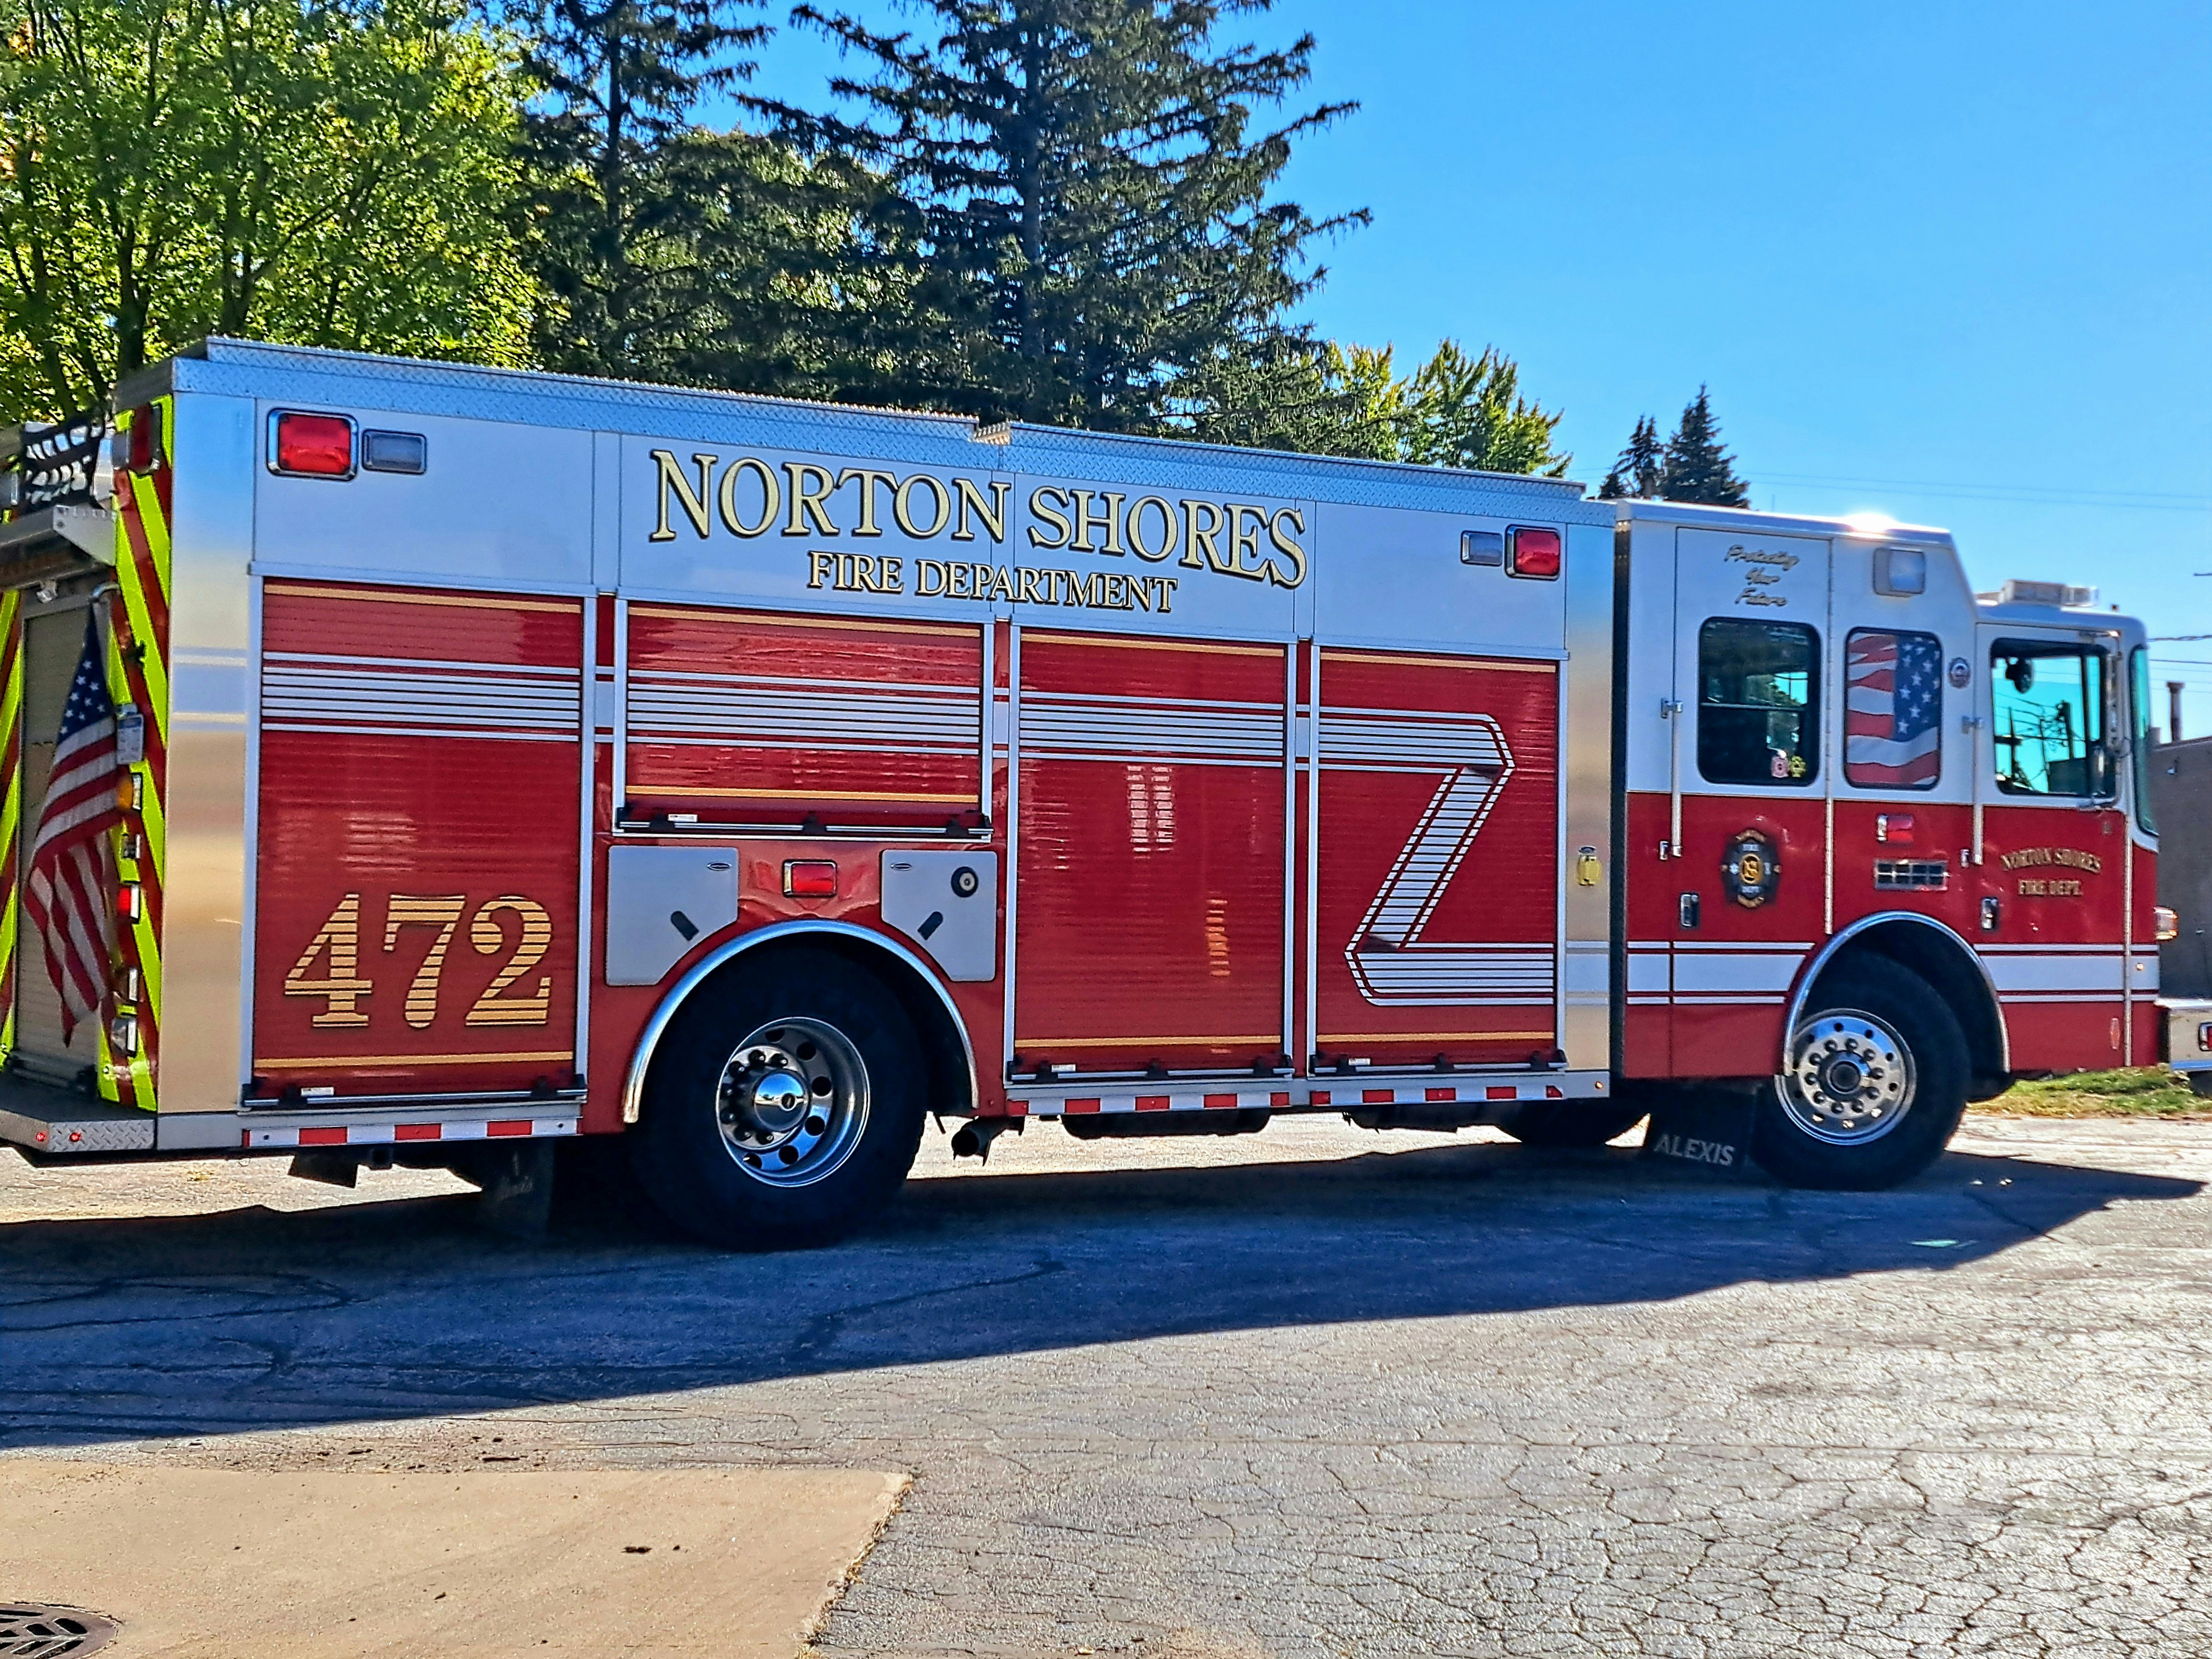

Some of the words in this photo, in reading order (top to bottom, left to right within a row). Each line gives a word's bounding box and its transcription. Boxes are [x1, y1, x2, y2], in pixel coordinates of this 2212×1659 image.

[649, 449, 1014, 543] NORTON
[1028, 485, 1307, 589] SHORES
[807, 551, 904, 595] FIRE
[916, 558, 1178, 613] DEPARTMENT
[2001, 848, 2052, 871] NORTON
[2054, 848, 2101, 873] SHORES
[2018, 879, 2047, 896] FIRE
[284, 892, 553, 1029] 472
[1653, 1134, 1736, 1167] ALEXIS
